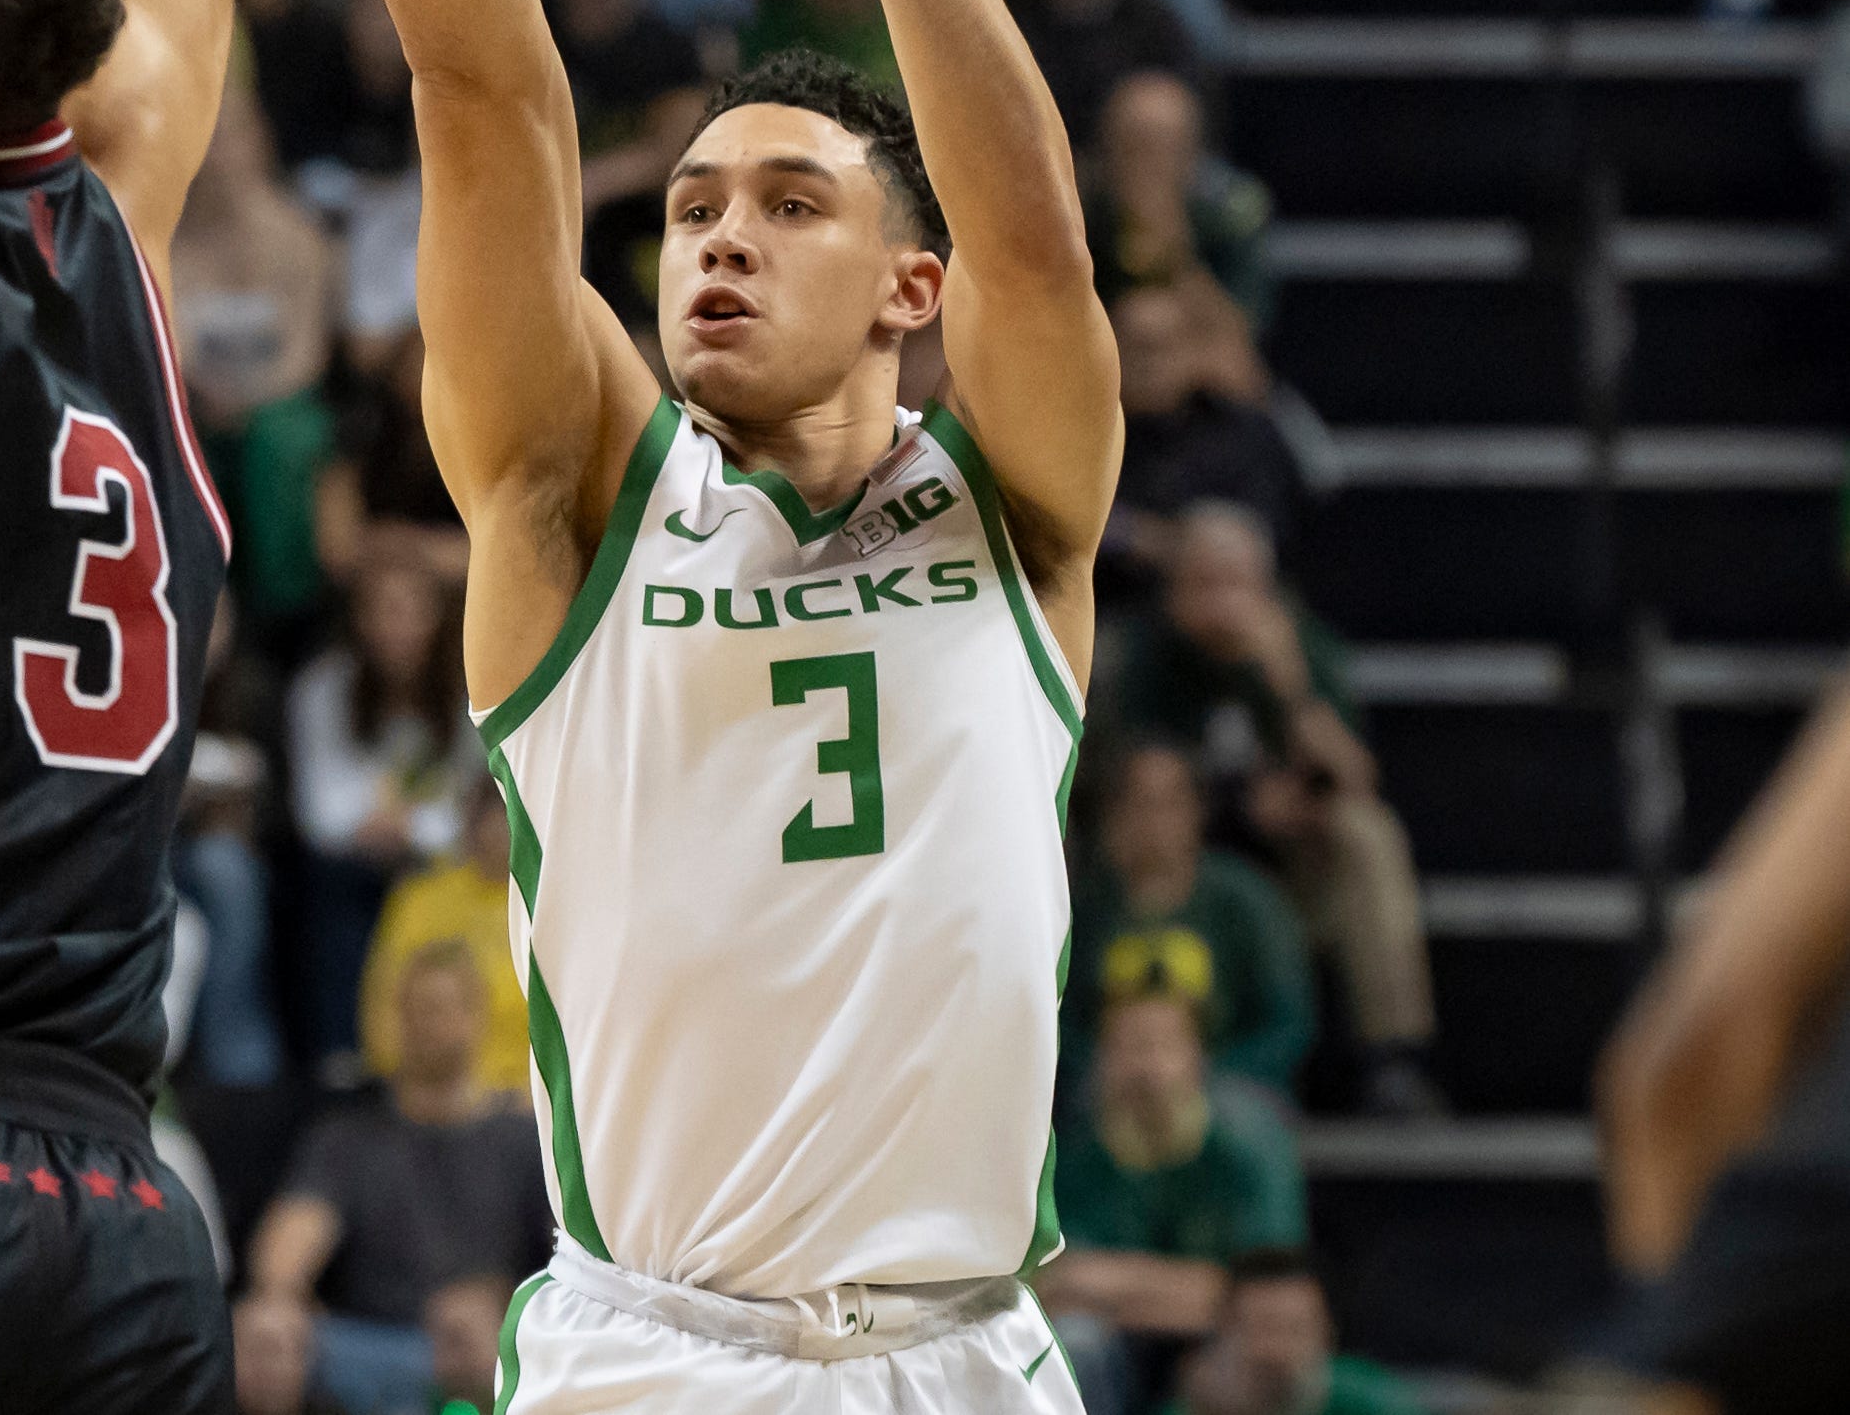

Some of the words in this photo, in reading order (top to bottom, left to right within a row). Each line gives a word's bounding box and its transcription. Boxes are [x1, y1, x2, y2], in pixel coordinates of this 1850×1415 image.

[14, 405, 178, 776] 3
[642, 560, 978, 629] DUCKS
[770, 651, 885, 864] 3
